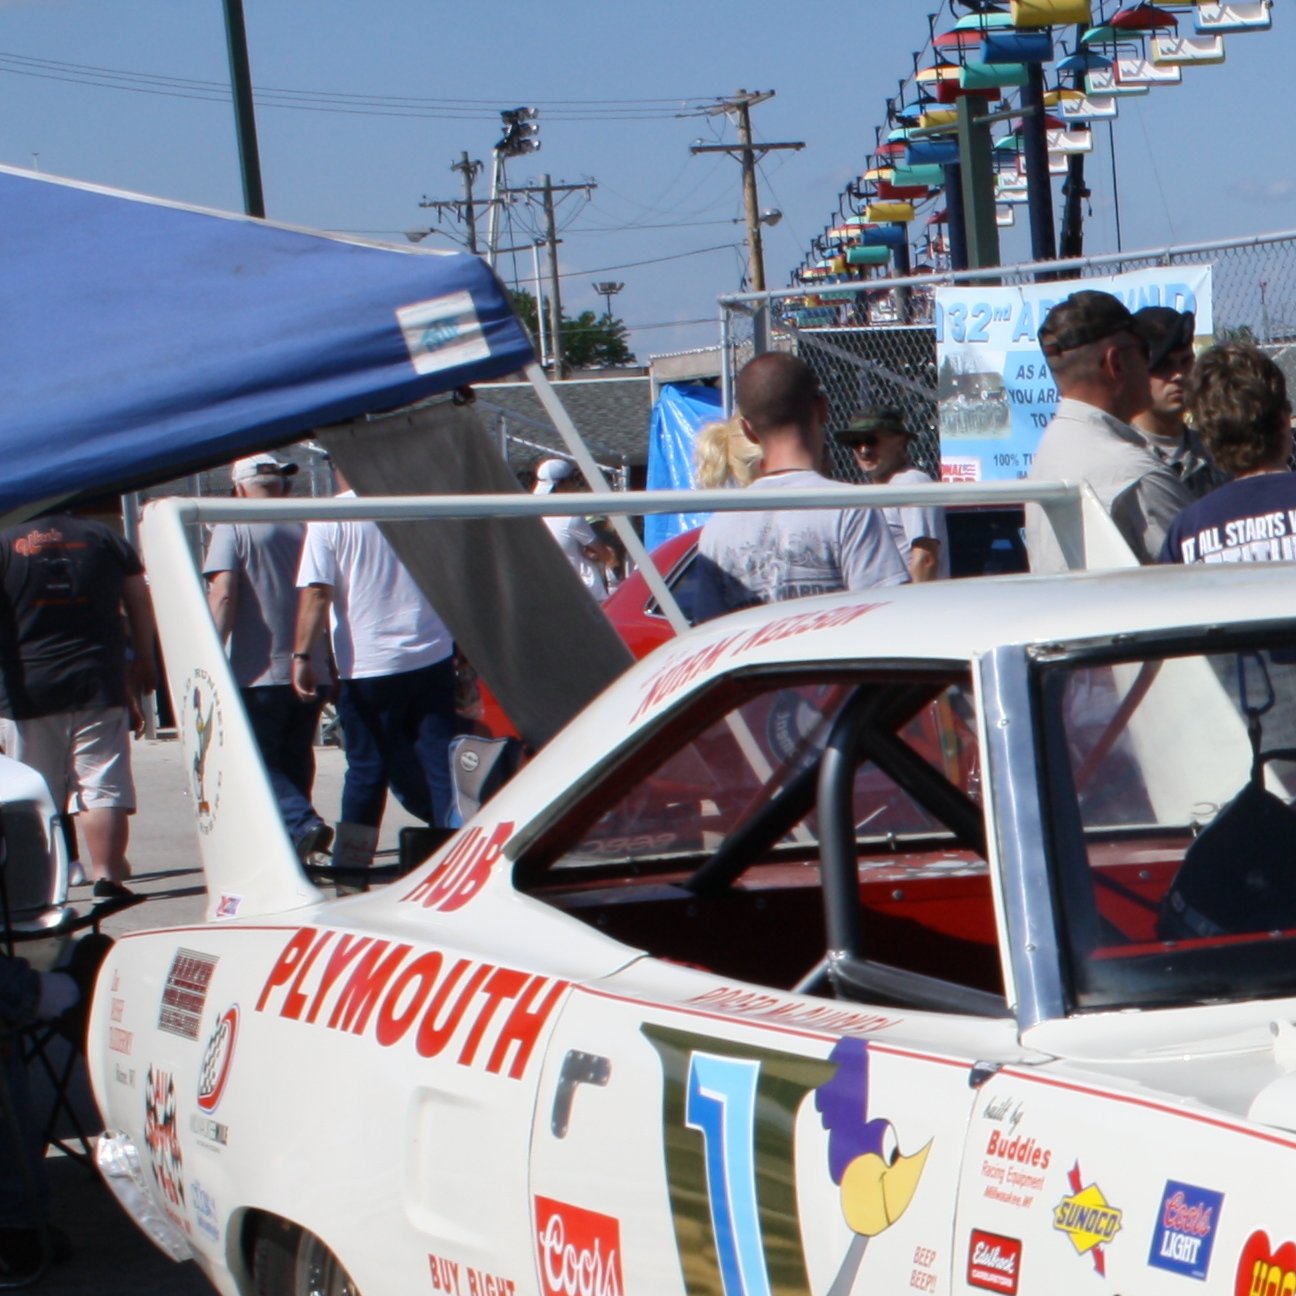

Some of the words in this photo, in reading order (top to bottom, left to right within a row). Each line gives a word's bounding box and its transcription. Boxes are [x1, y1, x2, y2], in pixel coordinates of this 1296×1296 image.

[1008, 388, 1034, 404] YOU
[993, 453, 1020, 466] 100%
[1199, 527, 1223, 556] ALL
[1225, 511, 1286, 547] STARTS
[255, 927, 570, 1079] PLYMOUTH
[985, 1129, 1052, 1170] Buddies
[982, 1160, 1006, 1185] Racing
[1006, 1166, 1046, 1191] Equipment
[1055, 1201, 1119, 1238] SUNOCO
[1163, 1191, 1213, 1237] Coors
[913, 1246, 937, 1268] BEEP
[1159, 1230, 1202, 1265] LIGHT
[428, 1253, 461, 1296] BUY
